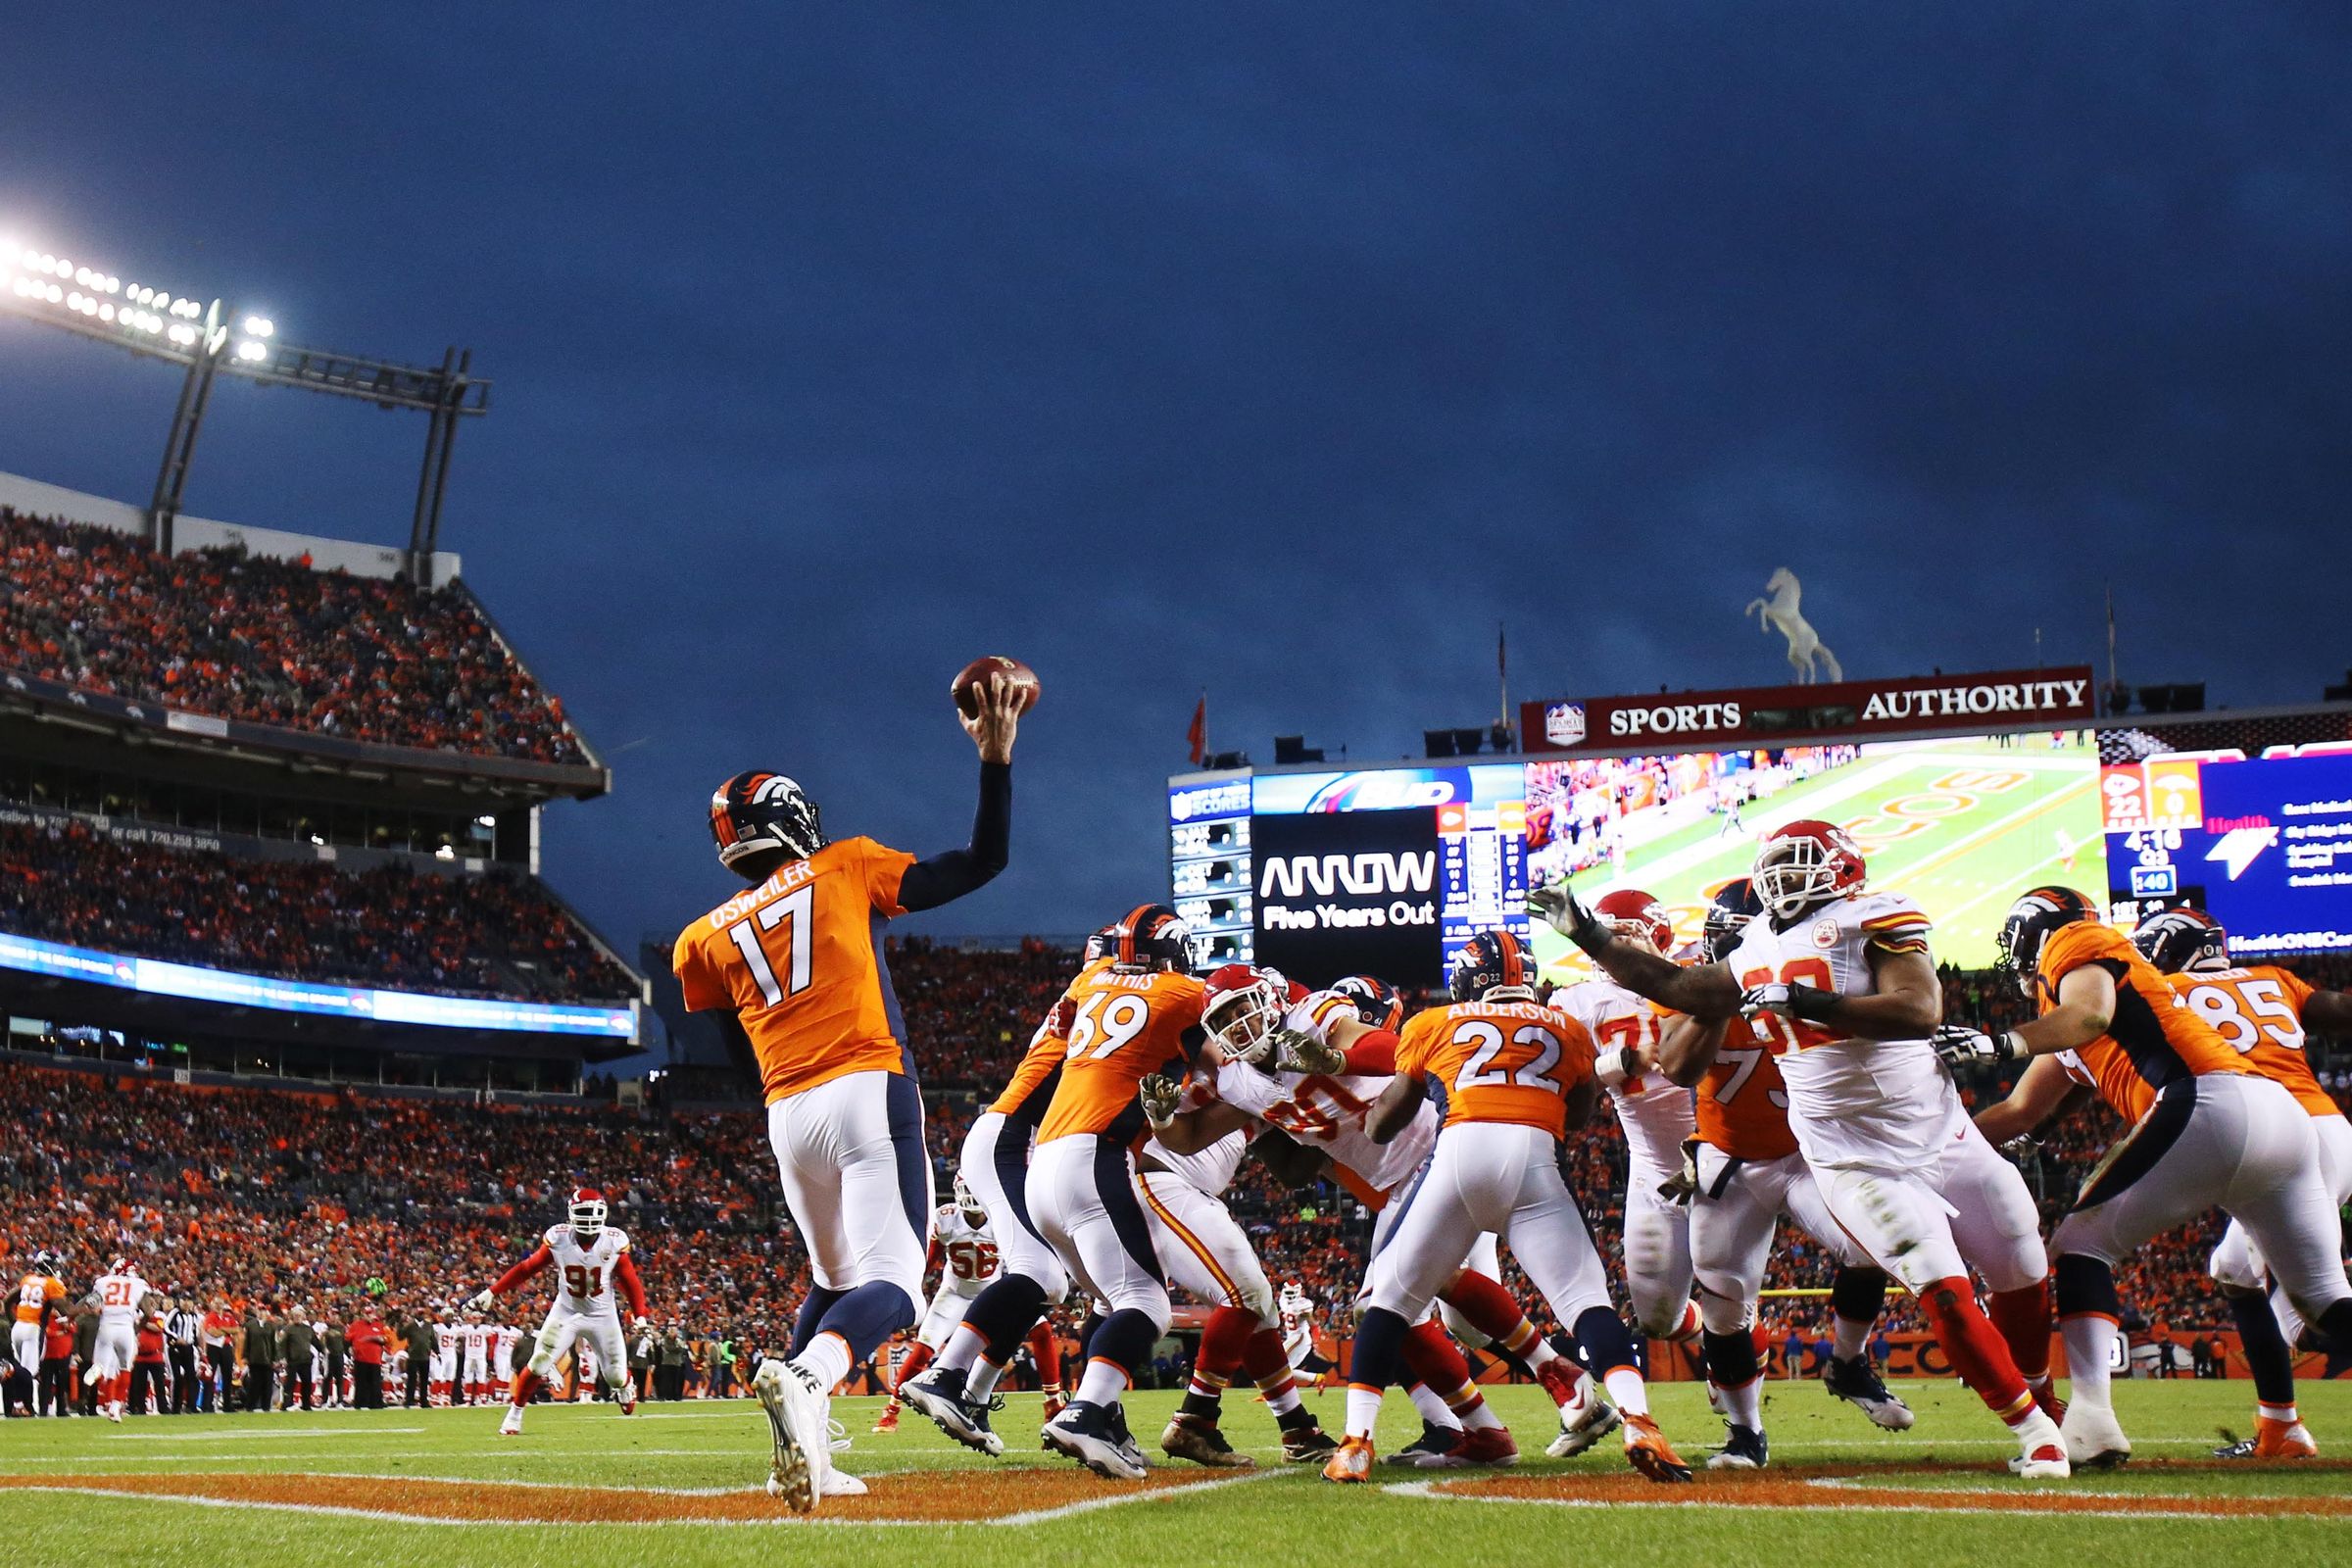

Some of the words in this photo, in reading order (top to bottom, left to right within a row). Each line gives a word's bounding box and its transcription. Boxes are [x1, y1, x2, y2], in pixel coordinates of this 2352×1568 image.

[1610, 702, 1741, 737] SPORTS
[1862, 679, 2087, 721] AUTHORITY
[1192, 795, 1250, 816] SCORES
[2109, 796, 2141, 817] 22
[2207, 815, 2271, 833] Health
[722, 845, 750, 861] RONCOS
[1259, 850, 1436, 899] ARROW
[710, 860, 815, 929] OSWEILER
[1263, 906, 1316, 930] Five
[1316, 904, 1386, 928] Years
[1389, 900, 1436, 925] Out
[729, 883, 814, 1008] 17
[1089, 971, 1159, 991] MATHIS
[1490, 973, 1500, 982] 22
[1066, 991, 1149, 1060] 69
[1447, 1003, 1566, 1029] ANDERSON
[2186, 980, 2306, 1054] 85
[1452, 1020, 1561, 1095] 22
[949, 1242, 1000, 1280] 56
[104, 1282, 131, 1306] 21
[564, 1264, 604, 1298] 91
[468, 1335, 482, 1348] 10
